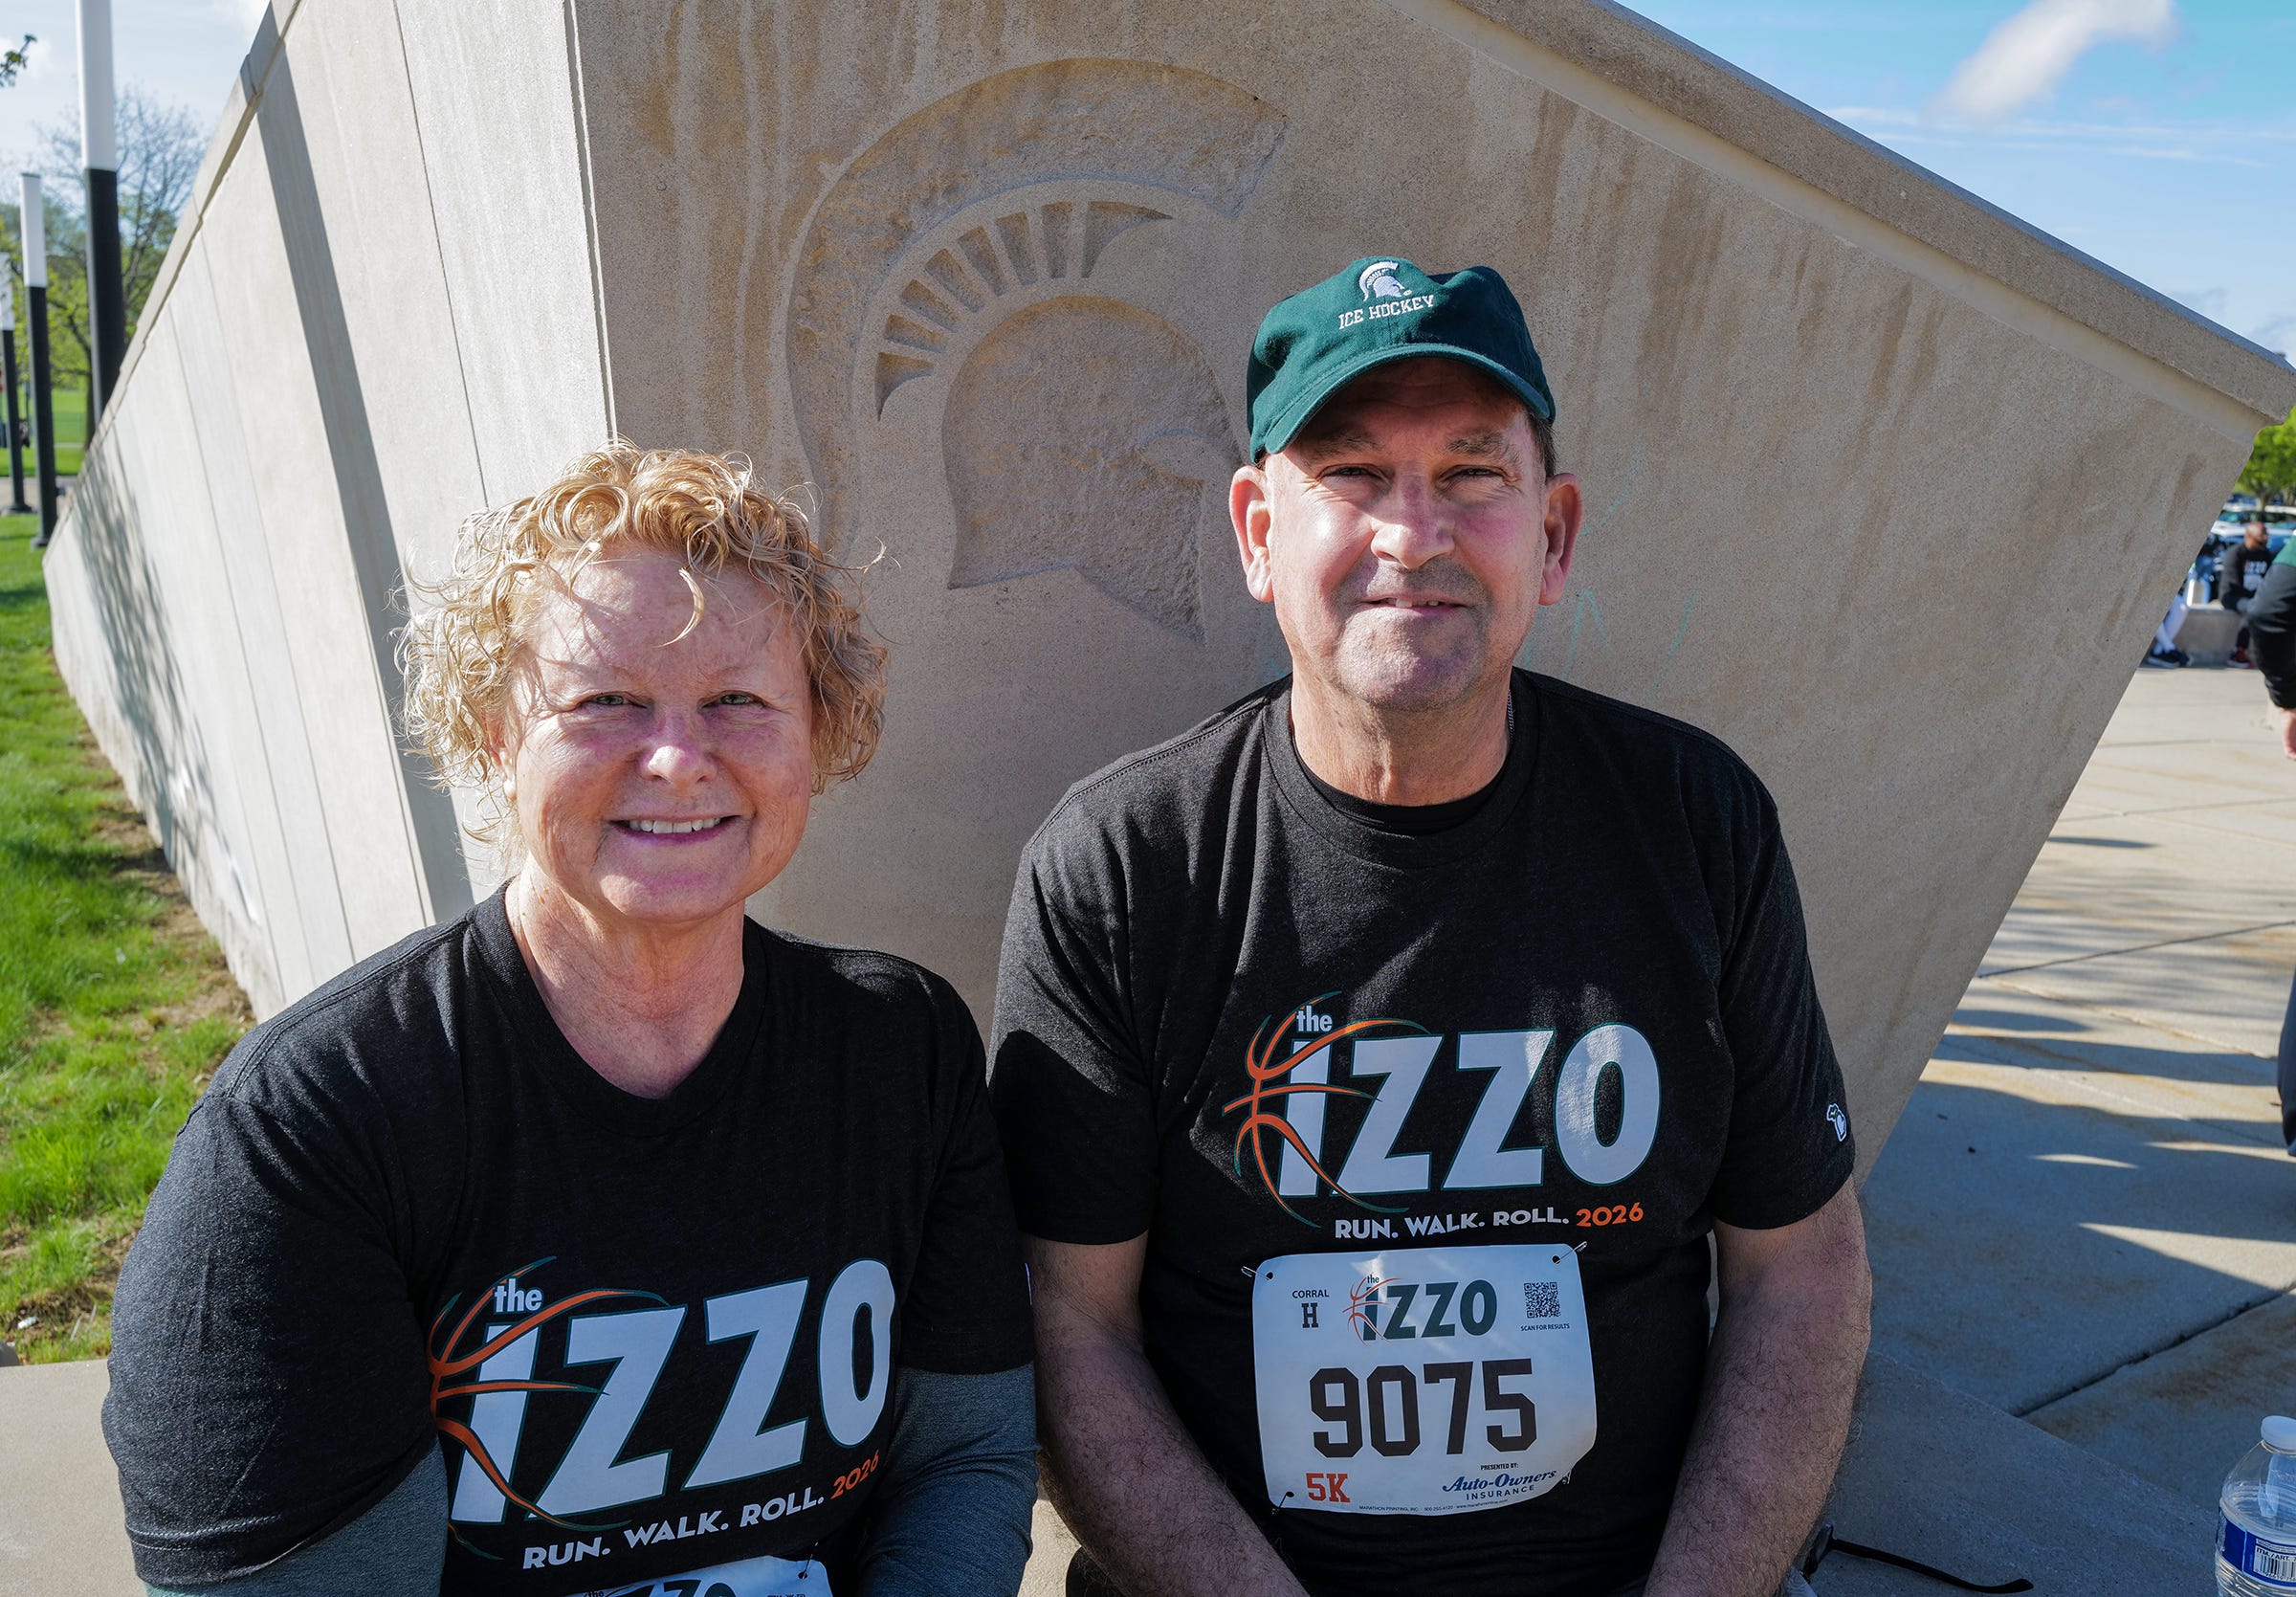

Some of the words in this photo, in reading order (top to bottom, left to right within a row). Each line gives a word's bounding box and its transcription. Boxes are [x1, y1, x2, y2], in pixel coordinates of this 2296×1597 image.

[1338, 308, 1364, 330] ICE
[1369, 295, 1434, 320] HOCKEY
[1296, 1005, 1333, 1032] the
[1277, 1022, 1662, 1197] IZZO
[1335, 1219, 1399, 1239] RUN.
[1404, 1212, 1486, 1237] WALK.
[1492, 1207, 1569, 1227] ROLL.
[1576, 1202, 1645, 1227] 2026
[494, 1277, 542, 1314] the
[1292, 1289, 1330, 1298] CORRAL
[1366, 1275, 1380, 1284] the
[1301, 1302, 1319, 1328] H
[1362, 1279, 1498, 1342] IZZO
[451, 1258, 895, 1524] IZZO
[1309, 1358, 1537, 1458] 9075
[1305, 1472, 1351, 1503] 5K
[1442, 1470, 1556, 1493] Auto-Owners
[1466, 1484, 1534, 1500] INSURANCE
[522, 1537, 610, 1570] RUN.
[624, 1510, 728, 1548] WALK.
[739, 1492, 824, 1527] ROLL.
[829, 1450, 880, 1500] 2026
